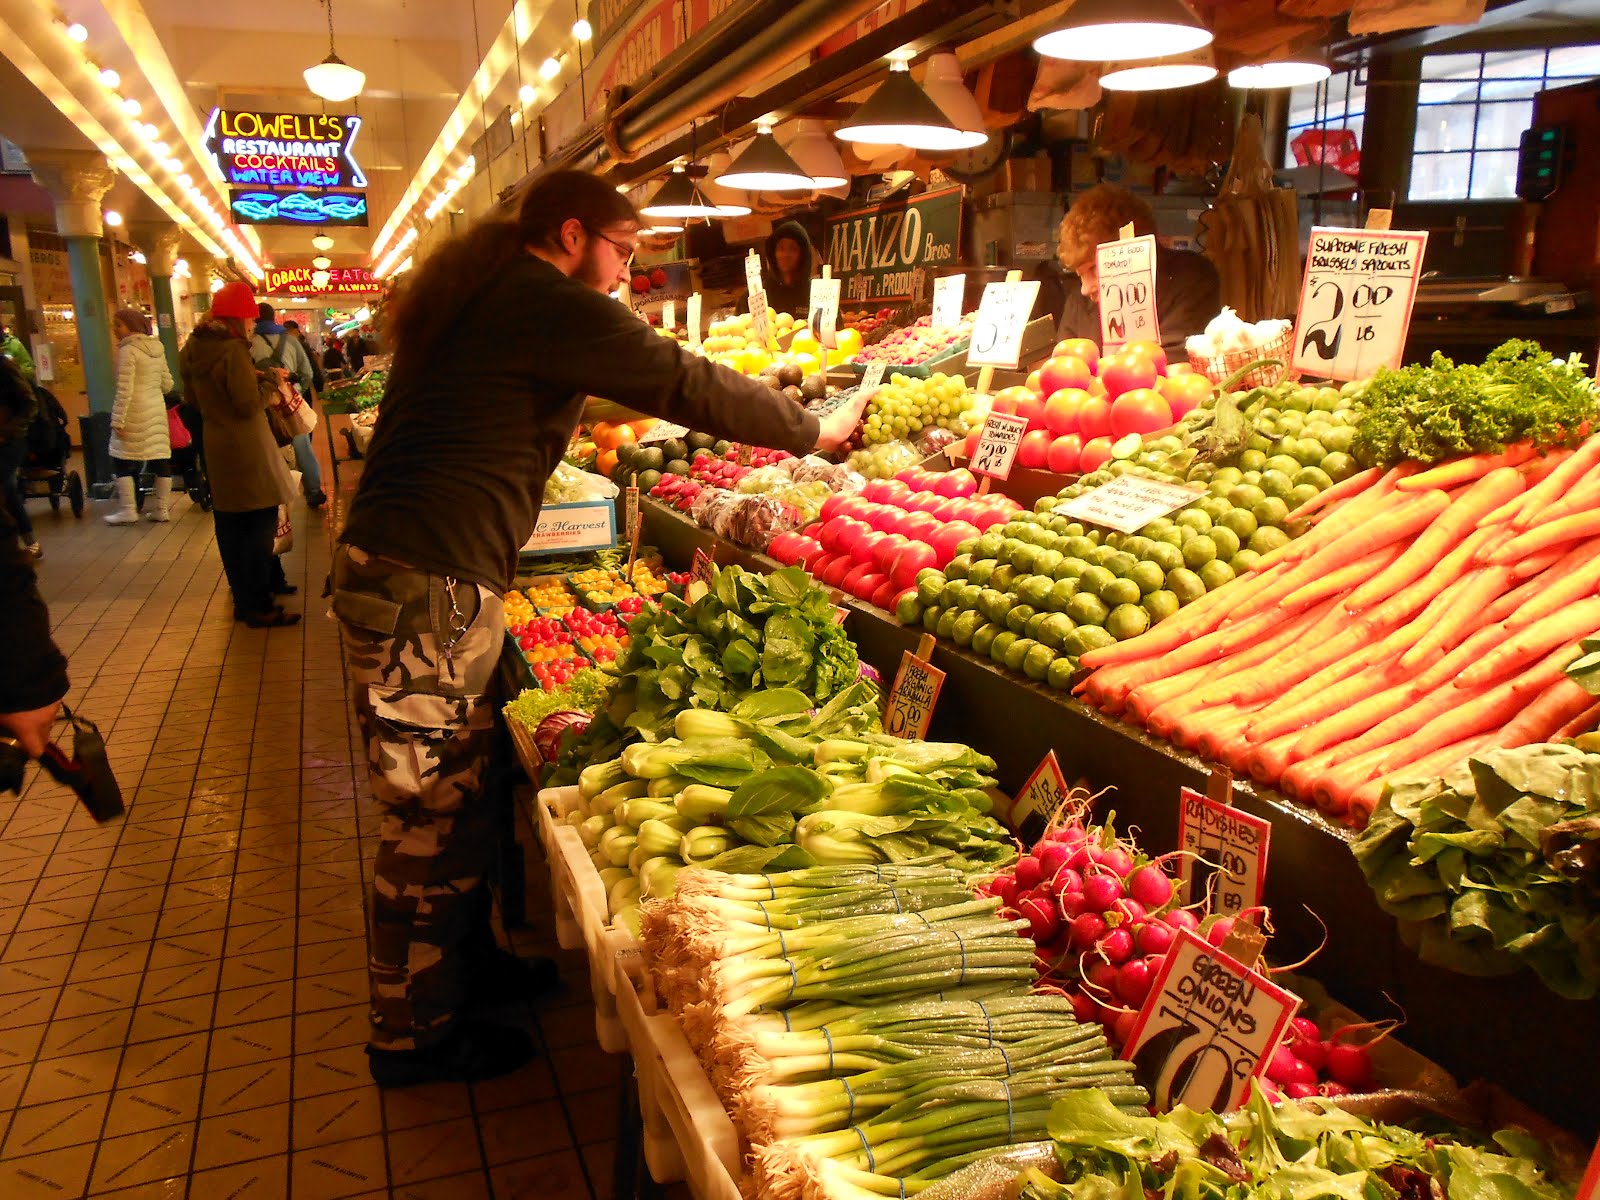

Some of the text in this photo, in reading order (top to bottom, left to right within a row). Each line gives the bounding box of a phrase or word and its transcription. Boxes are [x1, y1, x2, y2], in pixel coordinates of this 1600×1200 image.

[221, 111, 342, 139] LOWELL'S
[223, 139, 341, 157] RESTAURANT
[234, 155, 336, 171] COCKTAILS
[230, 169, 340, 186] WATER VIEW
[828, 207, 921, 272] MANZO
[1315, 238, 1408, 255] SUPREME FRESH
[1312, 256, 1410, 271] BRUSSELS SPROUTS
[265, 268, 311, 292] LOBACK
[338, 283, 379, 292] ALWAYS
[1356, 325, 1375, 341] LB
[532, 530, 581, 538] TRAWBERRIES
[551, 521, 606, 531] Harvest
[1192, 954, 1256, 1007] GREEN
[1177, 975, 1256, 1034] ONIONS
